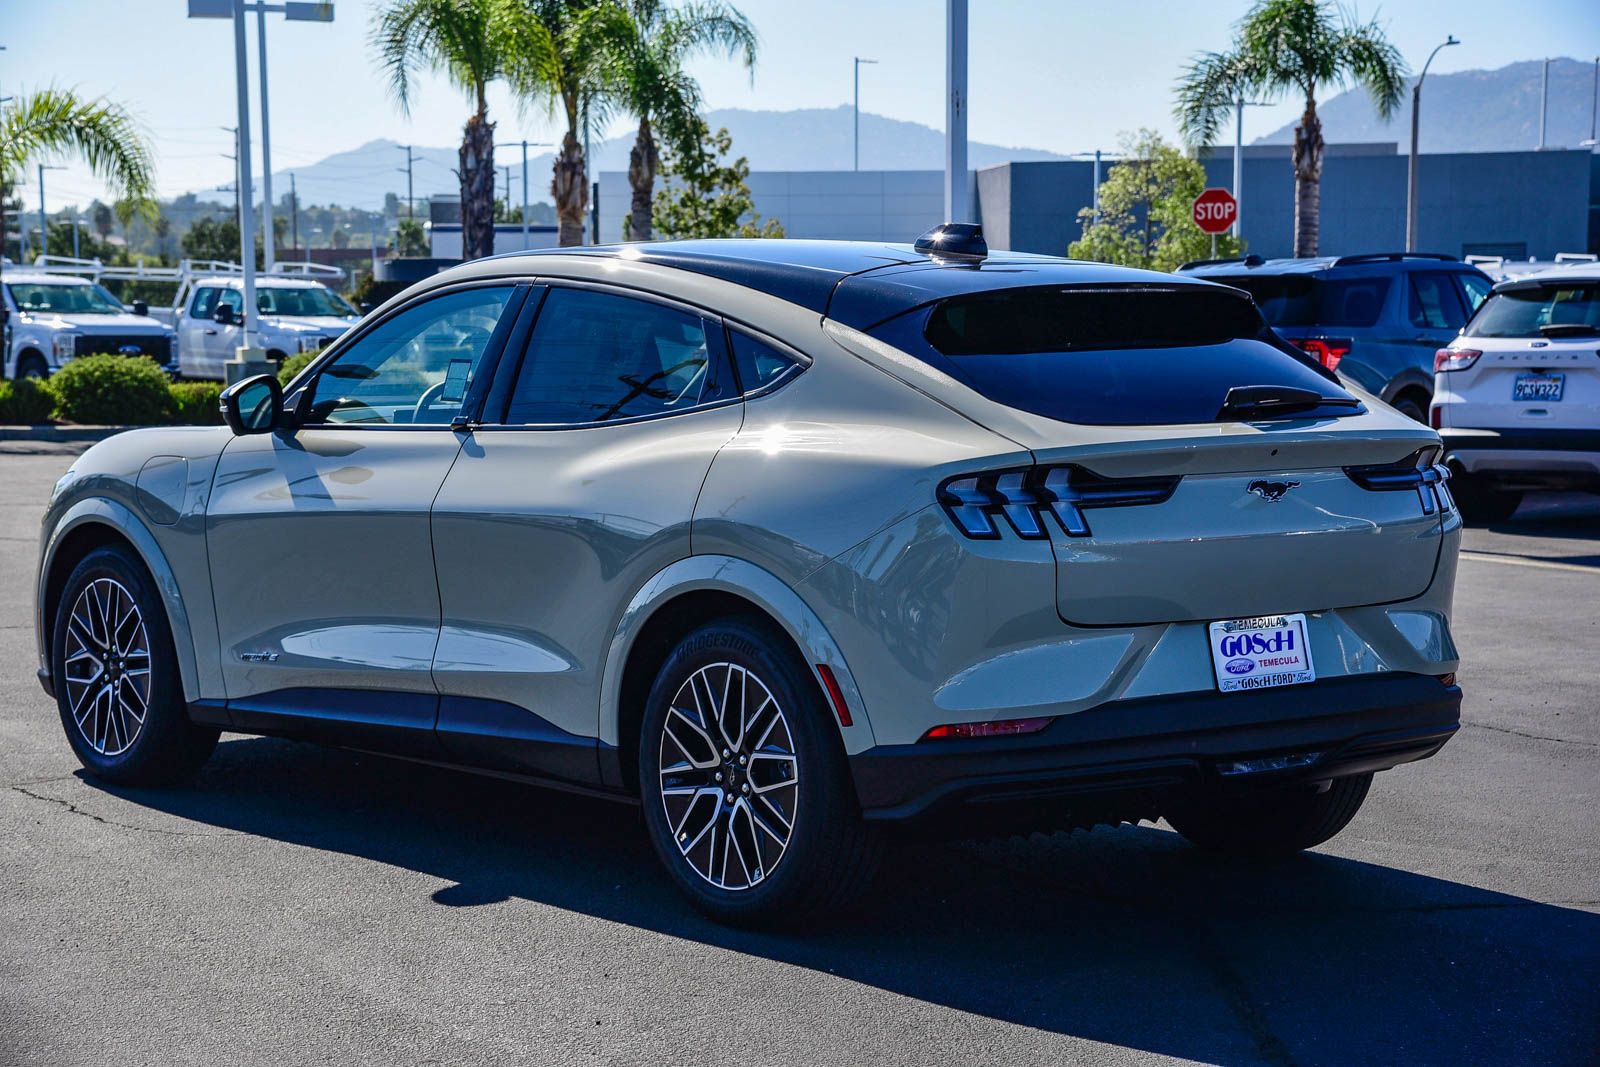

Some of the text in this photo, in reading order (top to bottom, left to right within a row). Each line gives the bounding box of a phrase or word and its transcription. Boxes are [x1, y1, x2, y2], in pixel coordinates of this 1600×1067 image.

[1195, 202, 1235, 220] STOP
[1516, 384, 1560, 397] 9CSW322
[1232, 617, 1283, 630] TEMECULA
[1229, 661, 1251, 673] Ford
[1258, 656, 1299, 668] TEMECULA
